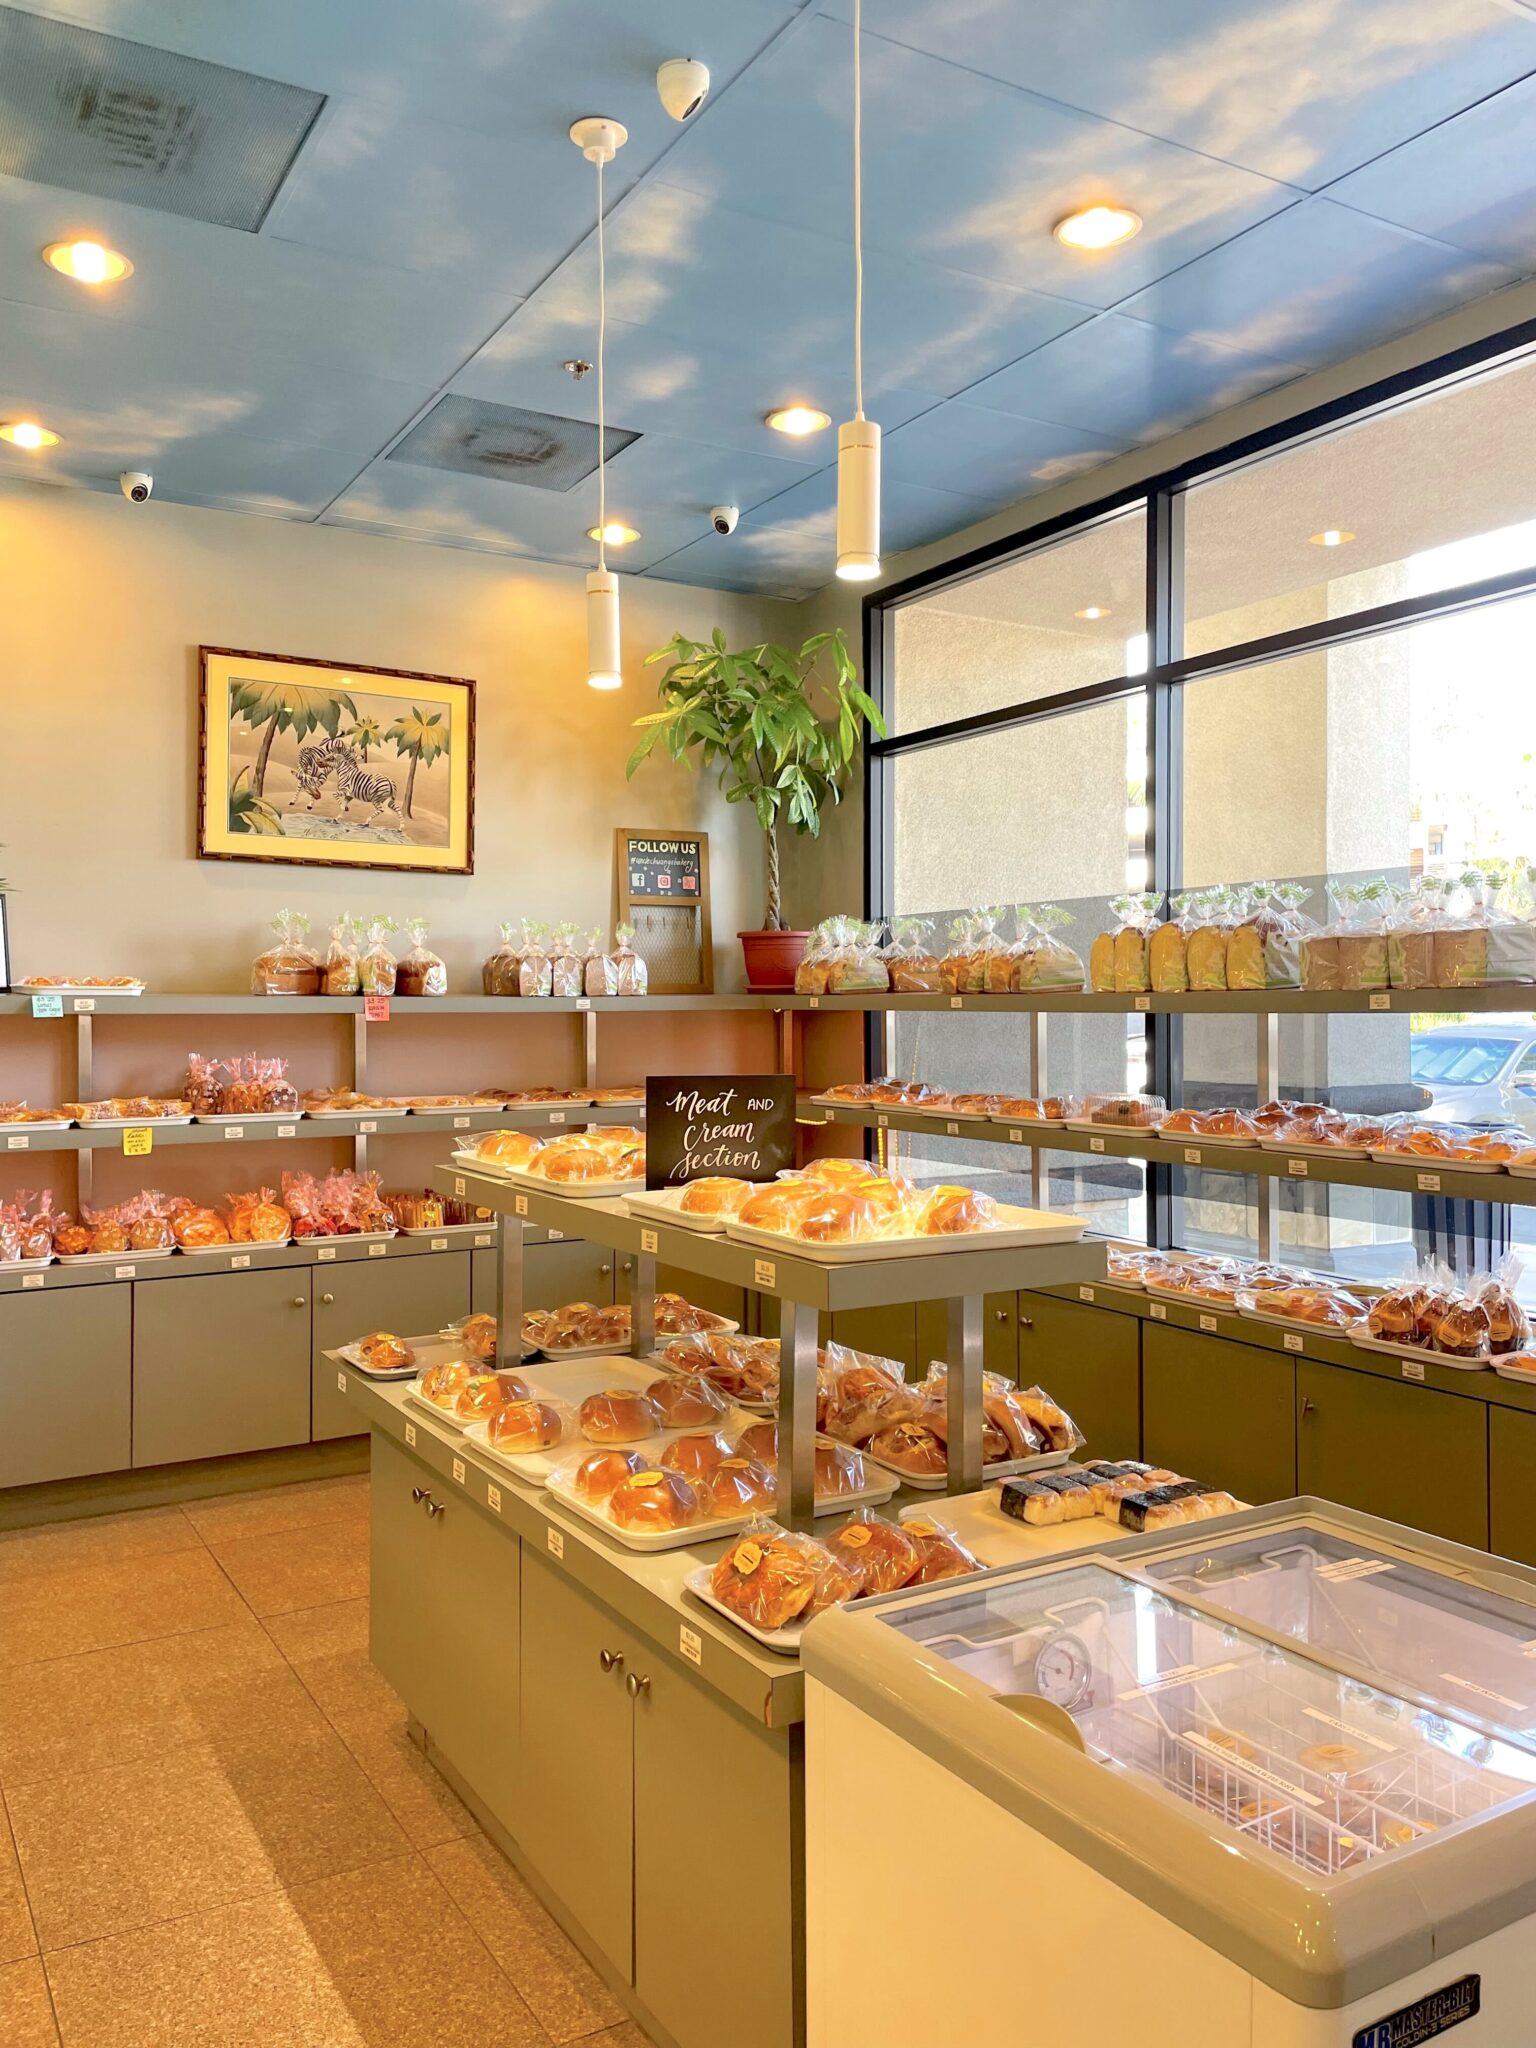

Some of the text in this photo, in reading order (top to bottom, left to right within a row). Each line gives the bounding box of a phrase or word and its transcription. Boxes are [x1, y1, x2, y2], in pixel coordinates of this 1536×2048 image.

[629, 841, 696, 855] FOLLOW US
[666, 1089, 775, 1121] Meat AND
[683, 1122, 755, 1152] Cream
[670, 1144, 761, 1179] section
[1440, 2004, 1471, 2028] SERIES
